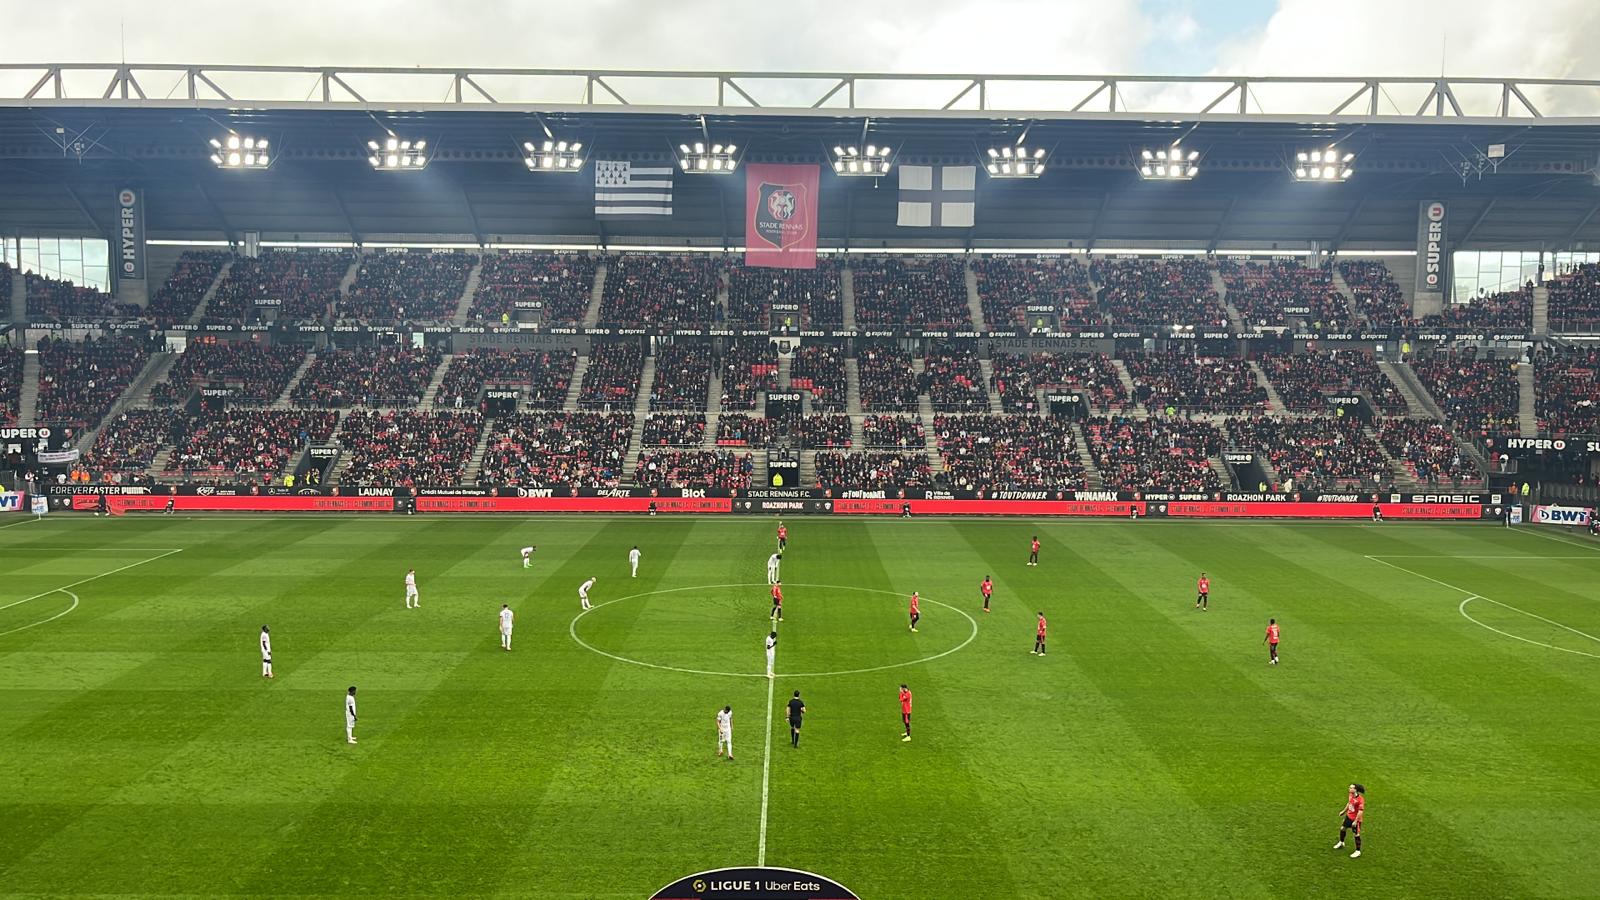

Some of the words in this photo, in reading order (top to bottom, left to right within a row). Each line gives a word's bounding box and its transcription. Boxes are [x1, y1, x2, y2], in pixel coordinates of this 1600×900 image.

[122, 208, 135, 260] HYPER
[1426, 222, 1442, 272] SUPER
[996, 339, 1028, 348] STADE
[1031, 339, 1077, 348] RENNAIS
[0, 428, 37, 439] UPER
[1508, 438, 1552, 449] HYPER
[358, 488, 394, 496] LAUNAY
[528, 488, 553, 497] BWT
[682, 489, 706, 498] Blot
[999, 492, 1047, 500] TOUTDONNER
[1074, 492, 1118, 501] WINAMAX
[1551, 510, 1587, 522] BWT
[710, 881, 750, 891] LIGUE
[754, 881, 760, 891] 1
[765, 881, 791, 891] Uber
[793, 881, 820, 891] Eats
